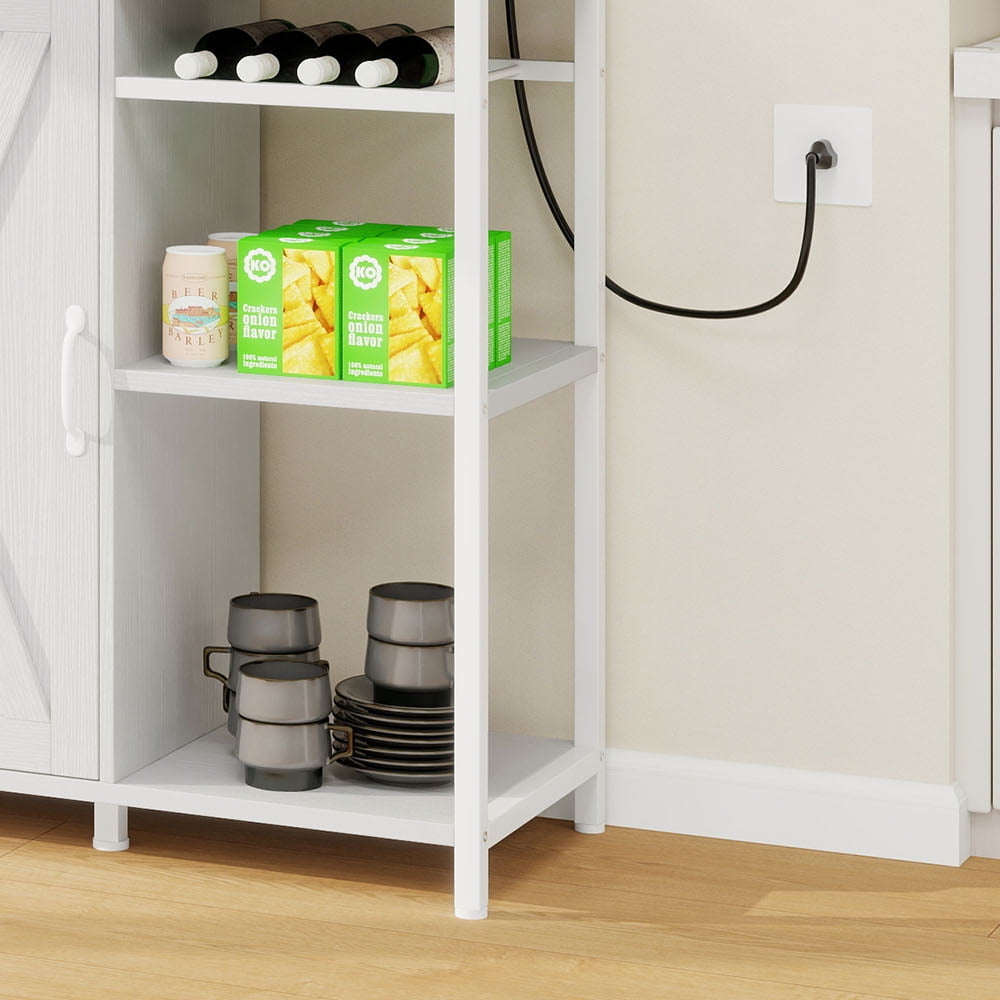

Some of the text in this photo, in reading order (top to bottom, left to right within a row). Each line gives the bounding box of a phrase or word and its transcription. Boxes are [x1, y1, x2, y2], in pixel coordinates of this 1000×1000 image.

[251, 260, 272, 272] KO
[356, 266, 378, 278] KO
[172, 288, 218, 300] BEER
[242, 304, 278, 314] Crackers
[243, 312, 277, 327] onion
[348, 311, 383, 322] Crackers
[243, 325, 277, 340] flavor
[348, 320, 383, 335] onion
[168, 326, 224, 346] BARLEY
[348, 332, 383, 348] flavor
